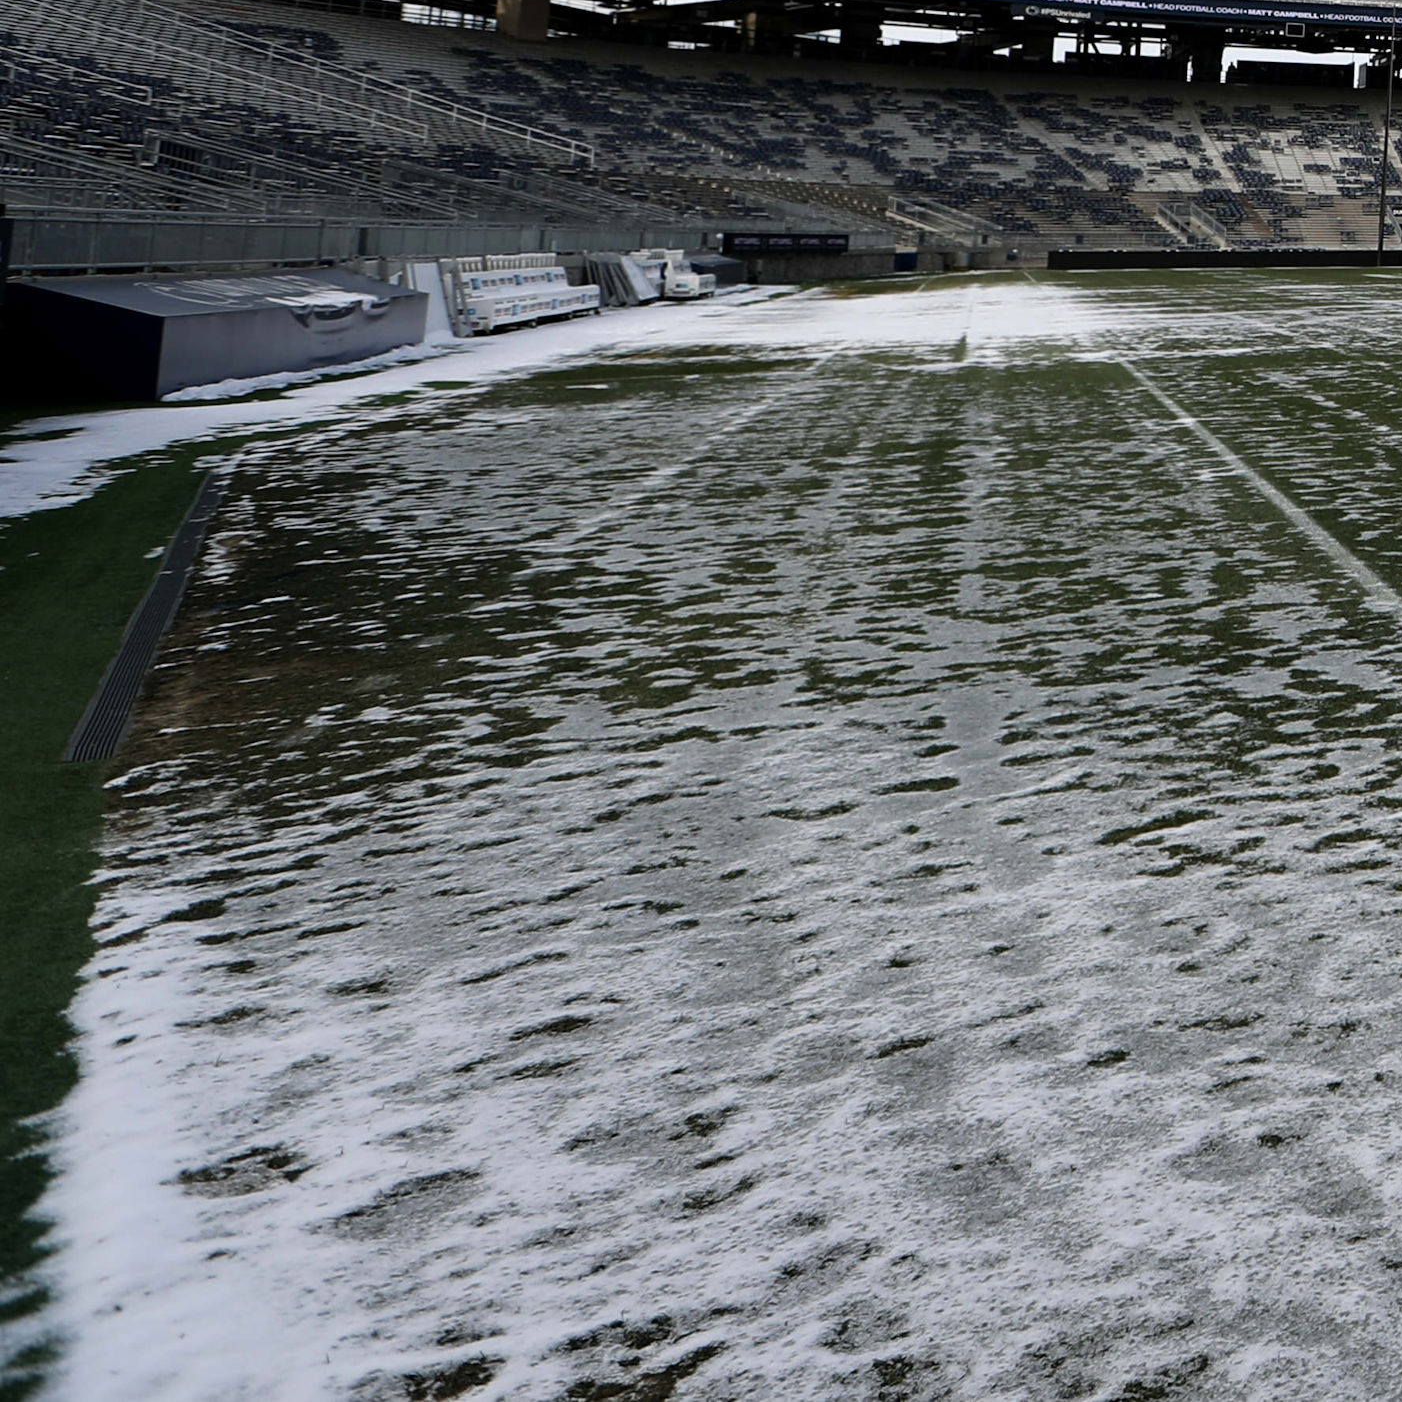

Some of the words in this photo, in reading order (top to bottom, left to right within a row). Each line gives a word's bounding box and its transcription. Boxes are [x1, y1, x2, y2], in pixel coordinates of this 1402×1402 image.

[1040, 8, 1091, 19] #PSUnrivaled
[1153, 3, 1174, 11] HEAD
[1175, 4, 1215, 14] FOOTBALL
[1216, 6, 1243, 15] COACH
[1248, 8, 1273, 17] MATT
[1273, 10, 1319, 20] CAMPBELL
[1324, 13, 1345, 21] HEAD
[1346, 14, 1382, 23] FOOTBALL
